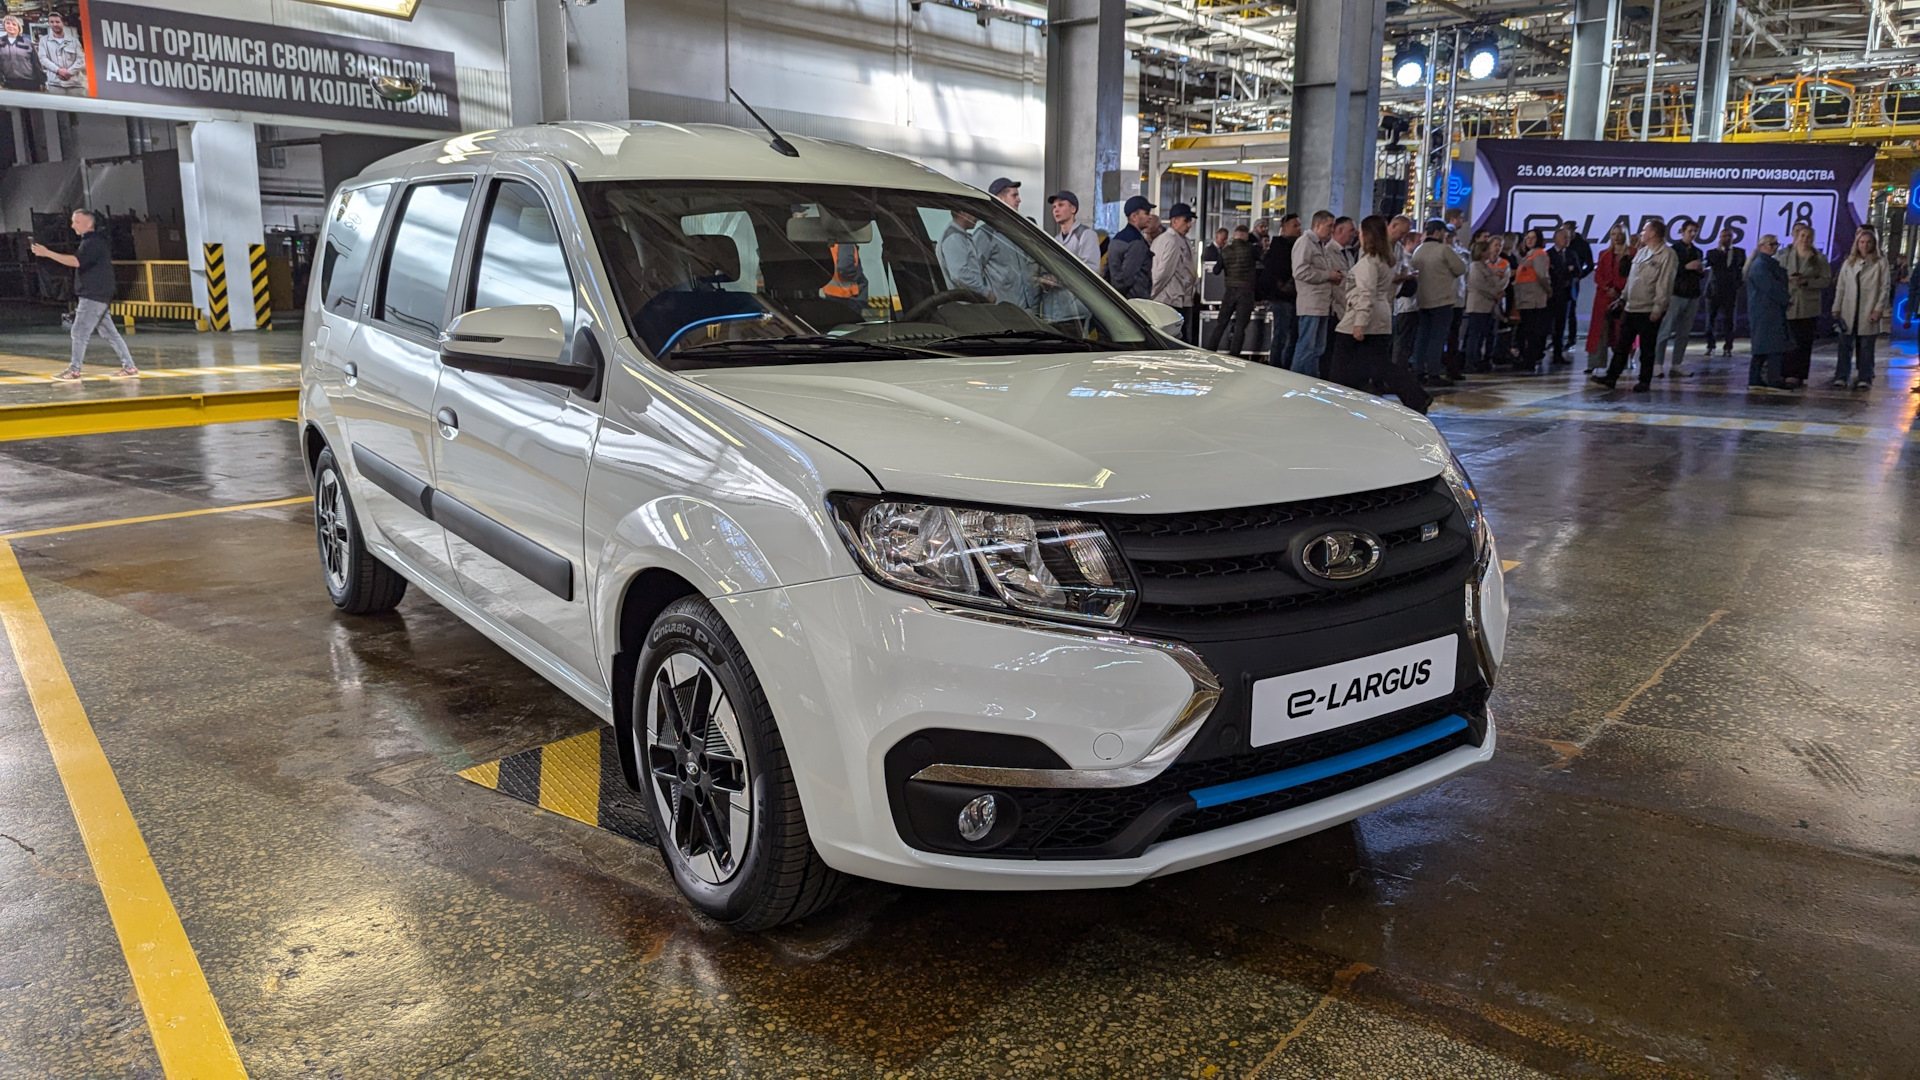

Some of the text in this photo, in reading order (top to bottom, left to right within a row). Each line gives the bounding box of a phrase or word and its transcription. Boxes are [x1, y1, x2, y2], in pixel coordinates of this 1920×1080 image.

[101, 19, 145, 52] МЫ
[150, 25, 268, 67] ГОРДИМСЯ
[272, 42, 340, 76] СВОИМ
[106, 53, 287, 100] АВТОМОБИЛЯМИ
[292, 75, 306, 102] И
[1517, 164, 1835, 182] 25.09.2024 СТАРТ ПРОМЫШЛЕННОГО ПРОИЗВОДСТВА
[1523, 213, 1748, 245] eLAGUS
[1778, 201, 1814, 237] 18
[1287, 658, 1432, 719] e-LARGUS
